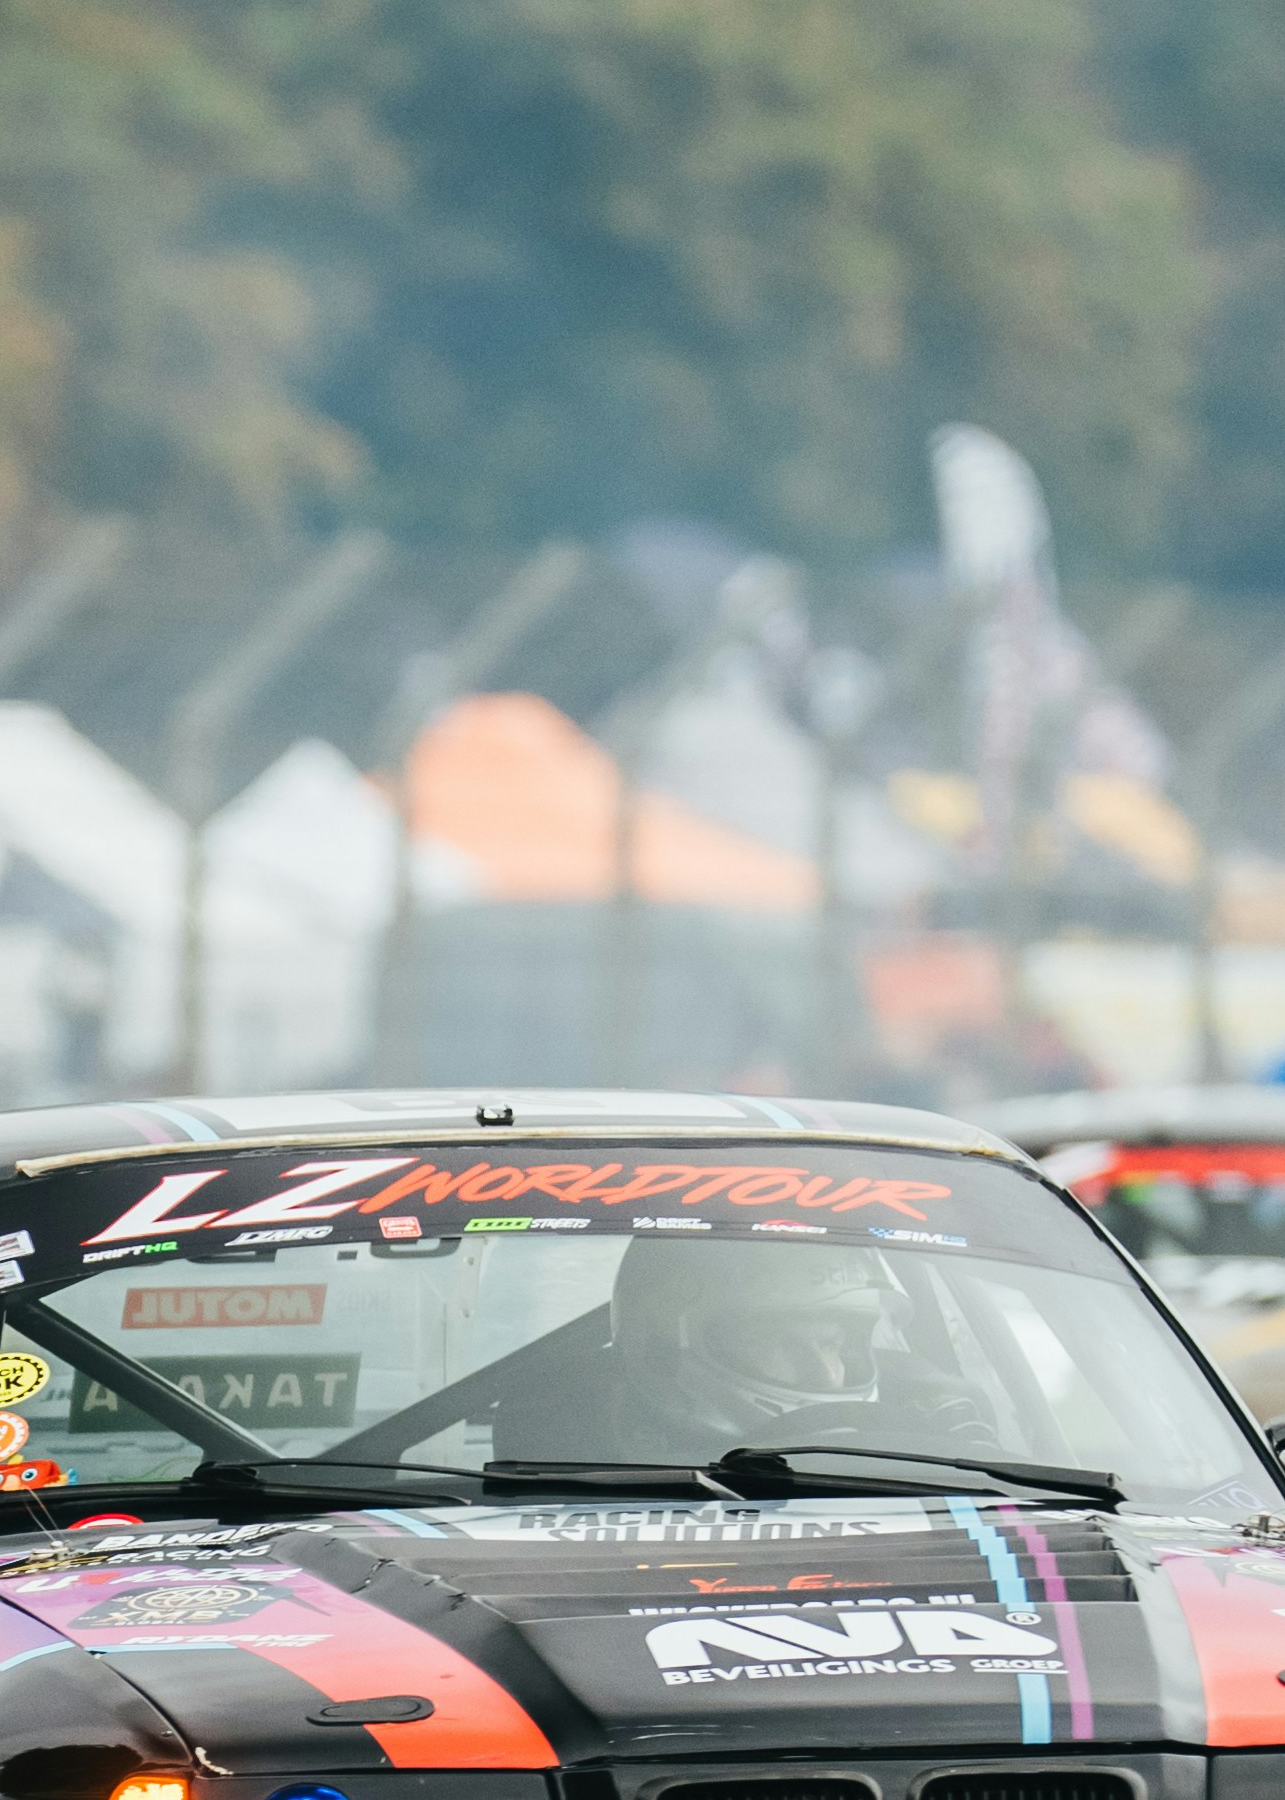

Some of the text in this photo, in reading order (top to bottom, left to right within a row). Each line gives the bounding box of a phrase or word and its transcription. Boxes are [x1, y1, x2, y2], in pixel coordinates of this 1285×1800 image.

[80, 1157, 952, 1246] LZ WORLDTOUR
[519, 1508, 761, 1530] RACING
[662, 1658, 1065, 1687] BEVEILIGINGS GROEP
